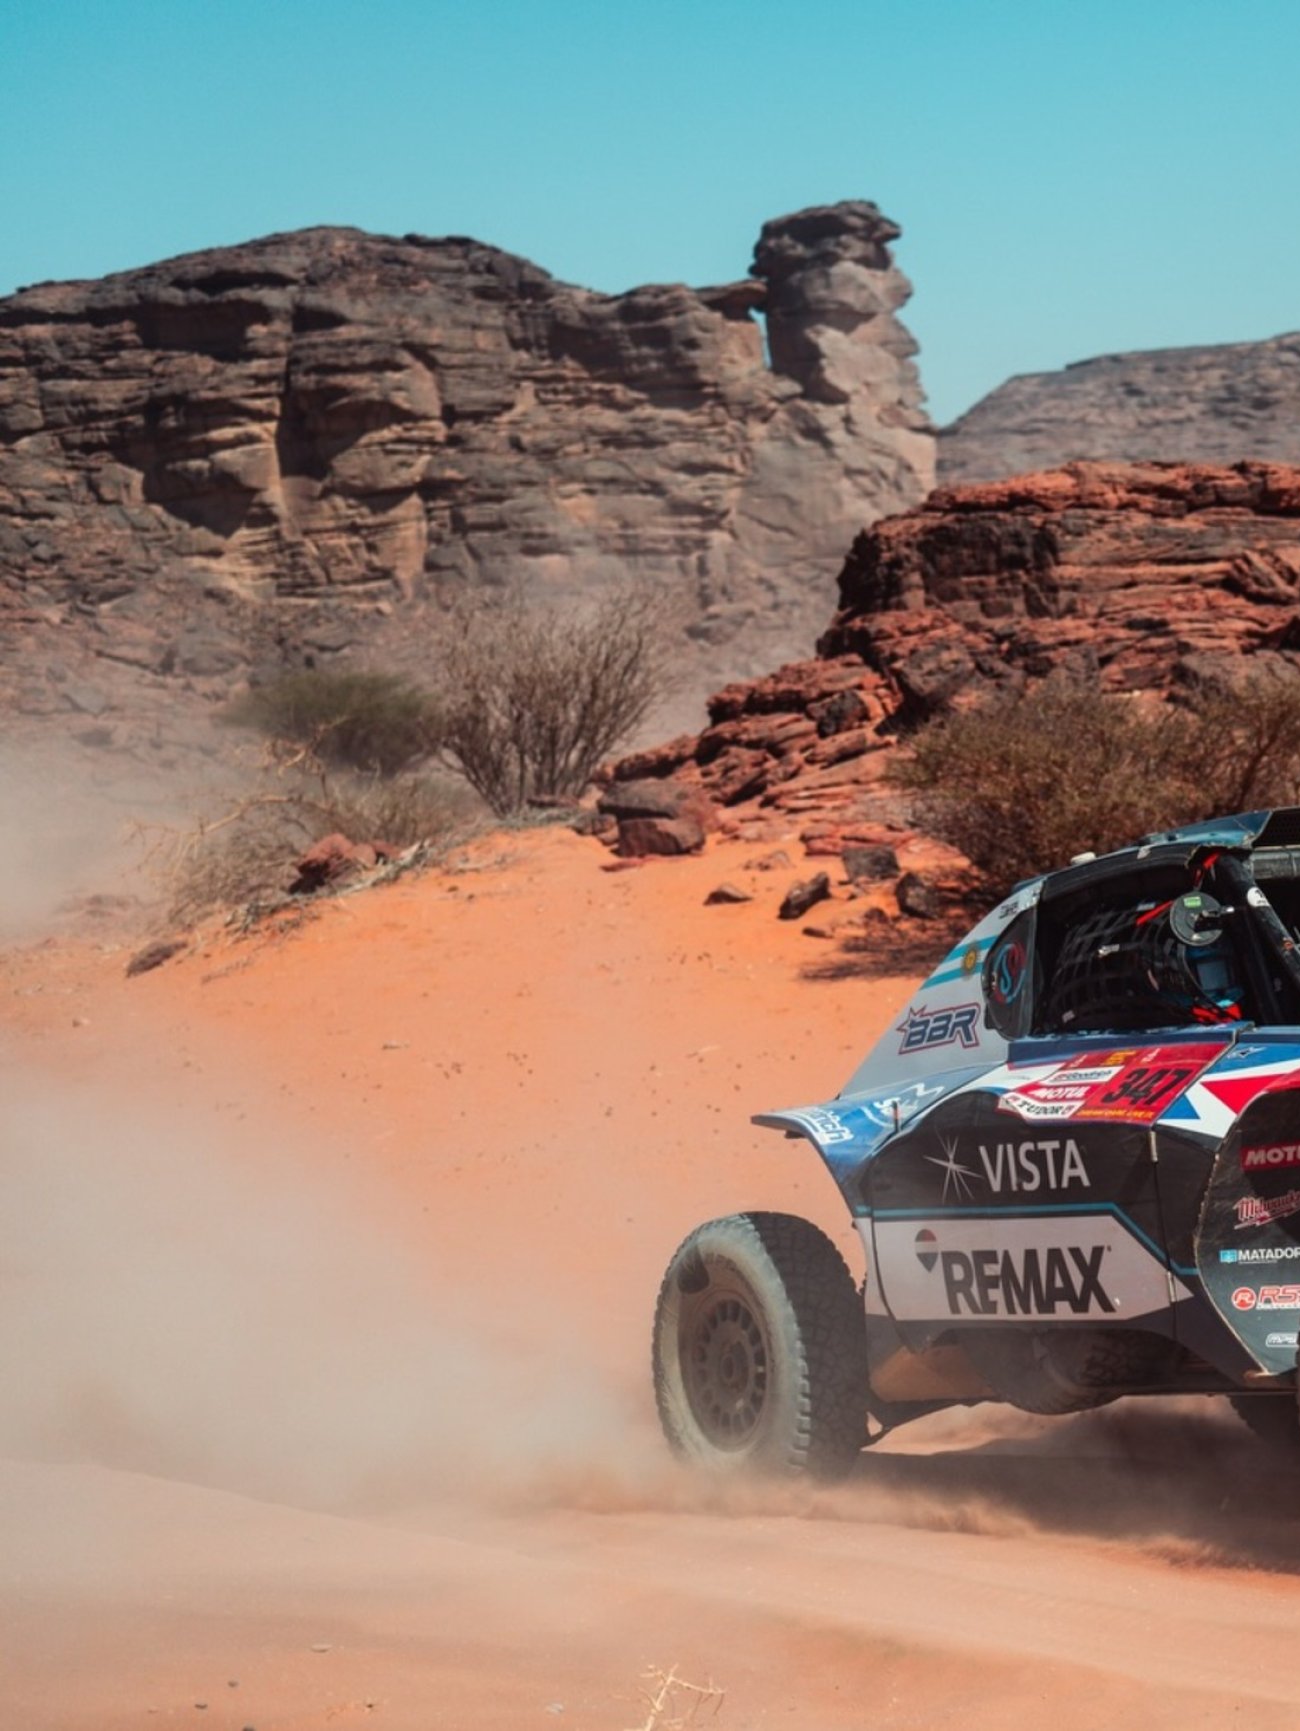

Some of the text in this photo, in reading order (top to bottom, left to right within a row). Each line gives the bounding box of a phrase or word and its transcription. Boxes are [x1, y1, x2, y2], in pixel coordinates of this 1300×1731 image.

[903, 1006, 977, 1048] BBR
[1028, 1085, 1091, 1099] MOTUL
[1100, 1068, 1193, 1105] 347
[1018, 1099, 1063, 1115] TUDOR
[979, 1139, 1091, 1192] VISTA
[940, 1245, 1116, 1315] REMAX
